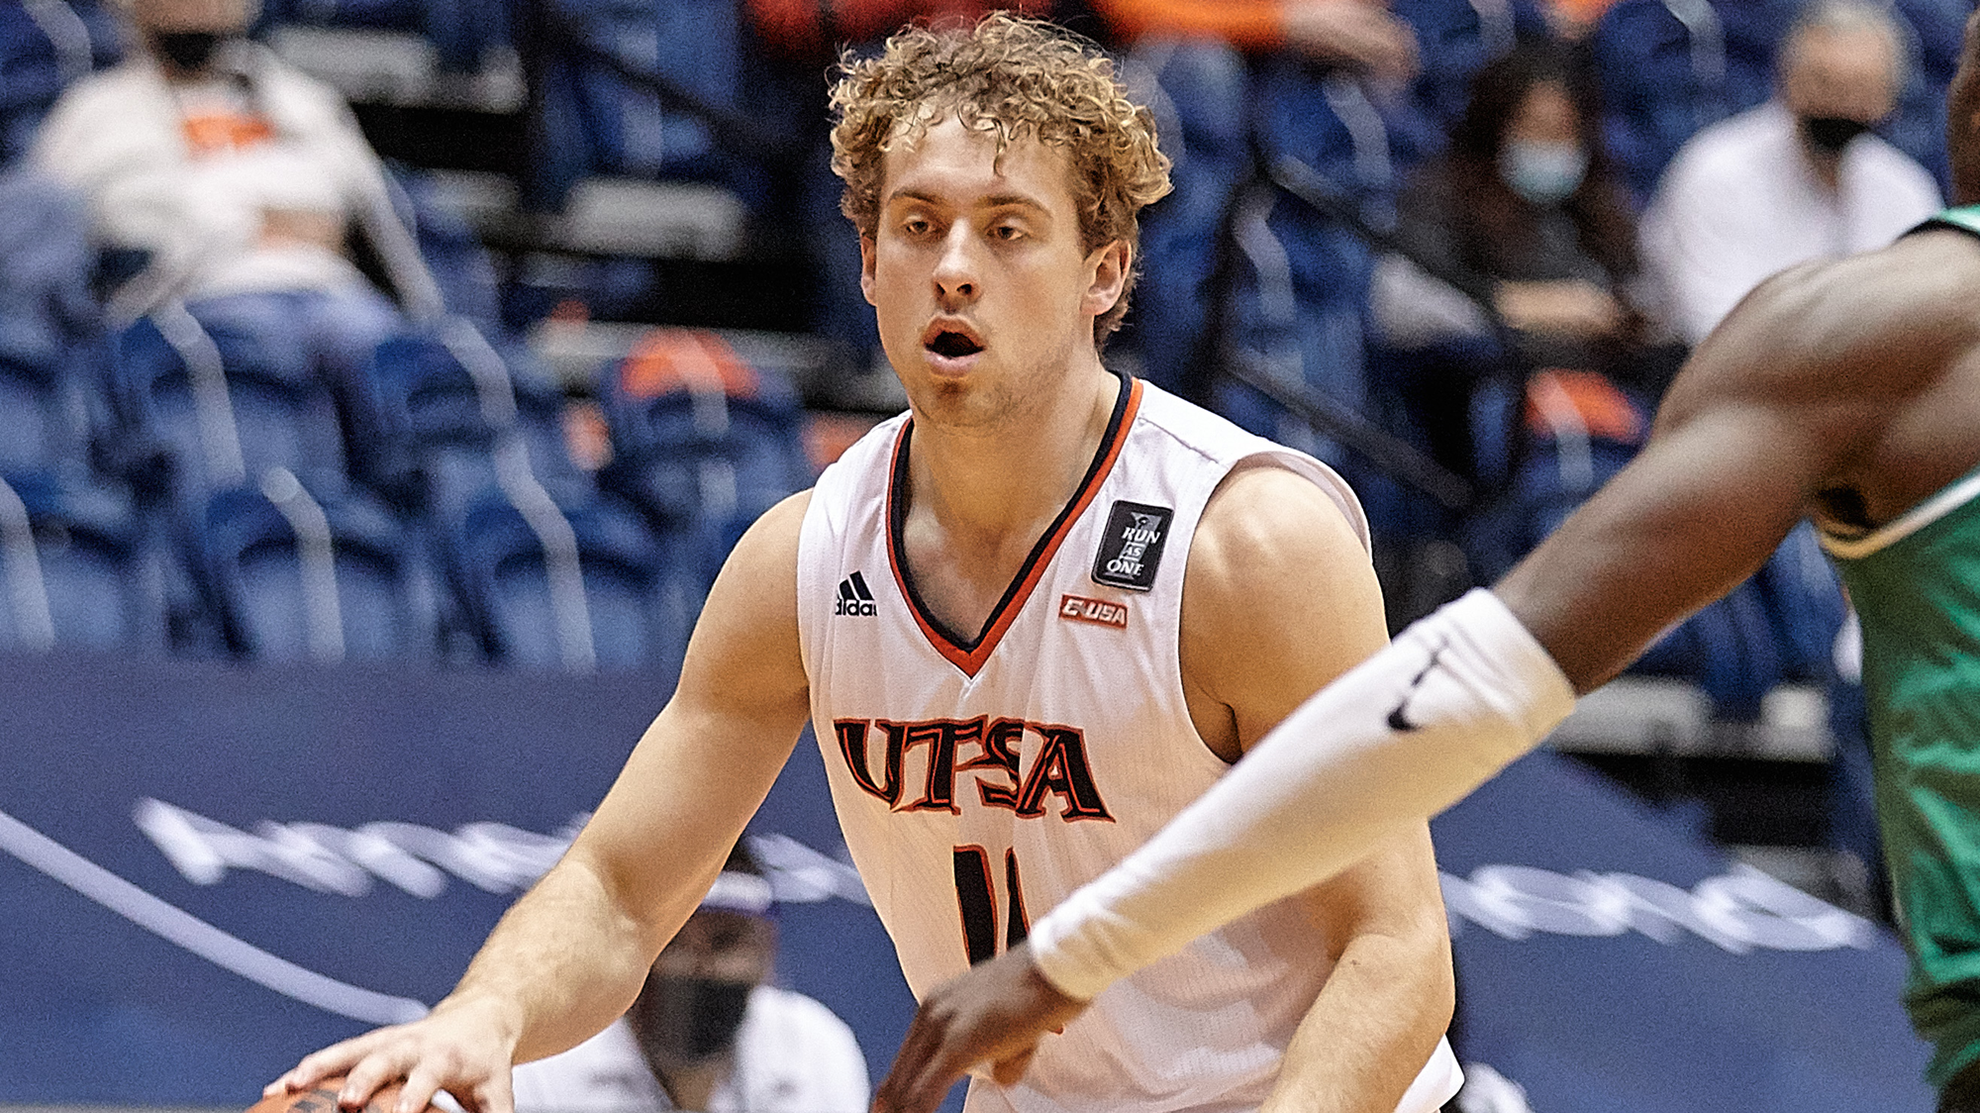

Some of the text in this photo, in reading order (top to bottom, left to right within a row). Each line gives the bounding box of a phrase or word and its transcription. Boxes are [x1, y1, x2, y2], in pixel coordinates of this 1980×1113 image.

[1121, 527, 1161, 544] RUN
[1125, 546, 1142, 557] AS
[1107, 559, 1145, 575] ONE
[833, 714, 1116, 823] UTSA
